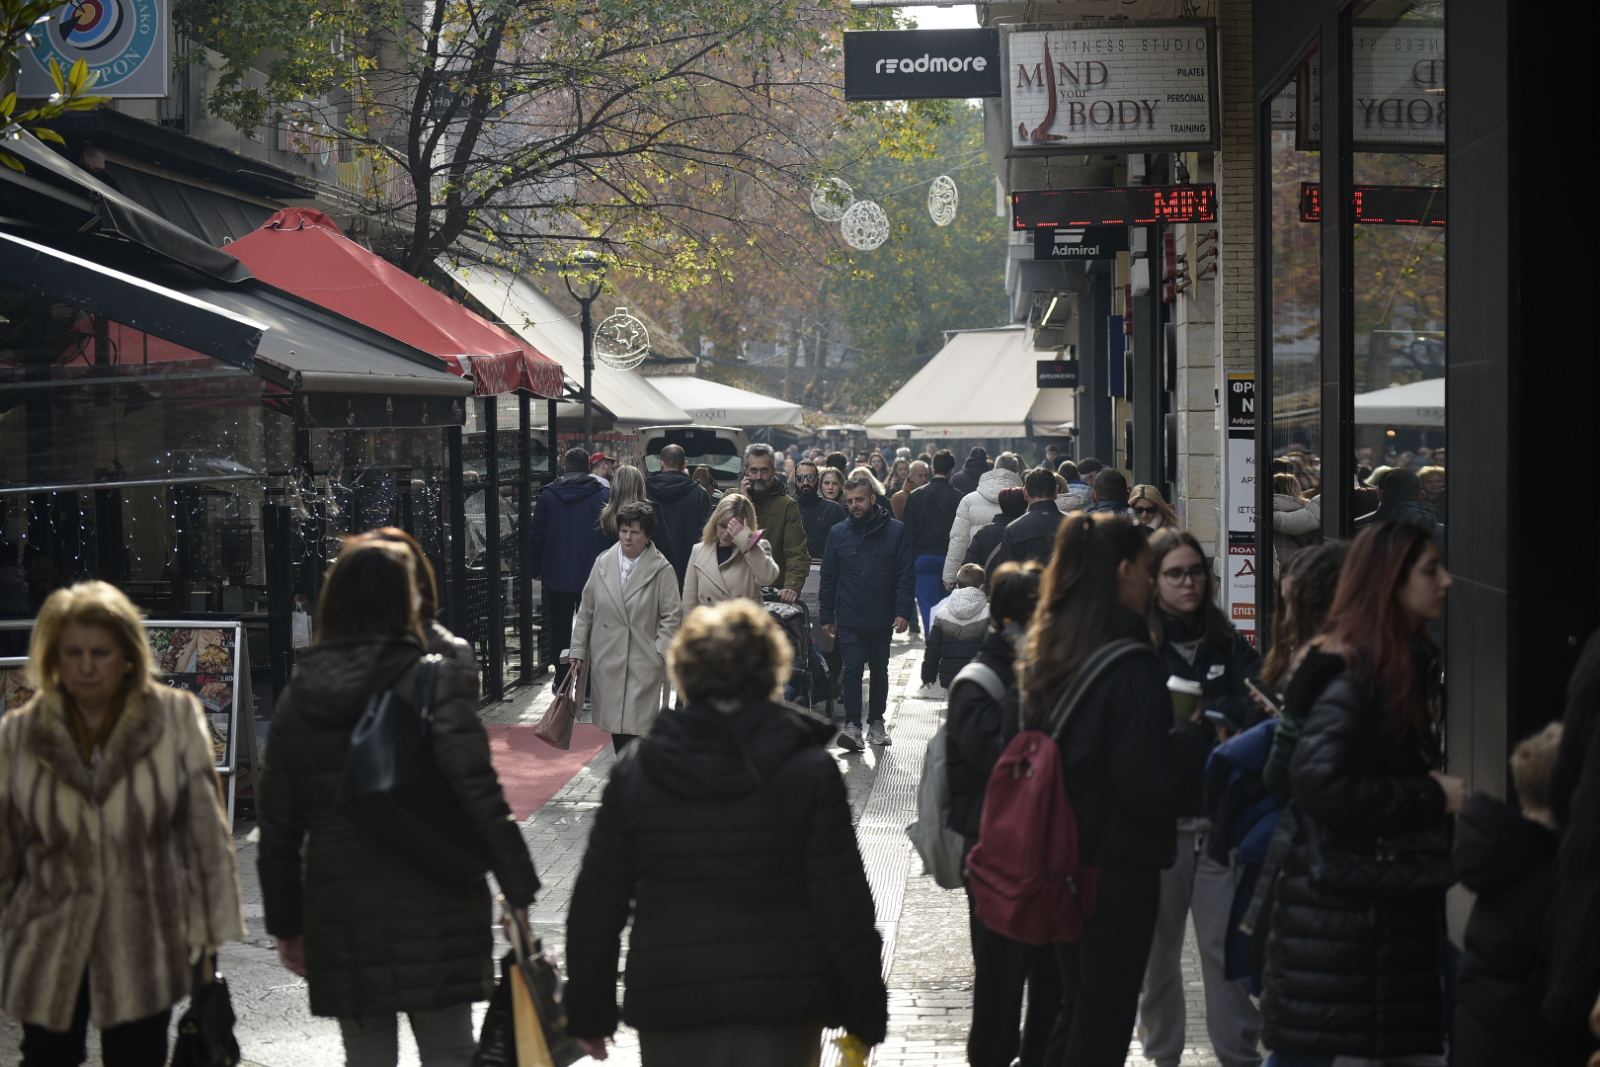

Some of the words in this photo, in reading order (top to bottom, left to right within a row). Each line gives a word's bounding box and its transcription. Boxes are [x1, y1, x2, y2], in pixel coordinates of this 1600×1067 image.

[1053, 40, 1125, 54] FITNESS
[1142, 38, 1205, 52] STUDIO
[875, 53, 988, 74] readmore
[1177, 67, 1205, 77] PILATES
[1059, 88, 1088, 101] your
[1166, 93, 1205, 103] PERSONAL
[1068, 99, 1160, 127] BODY
[1169, 123, 1206, 133] TRAINING
[1052, 243, 1100, 256] Admiral
